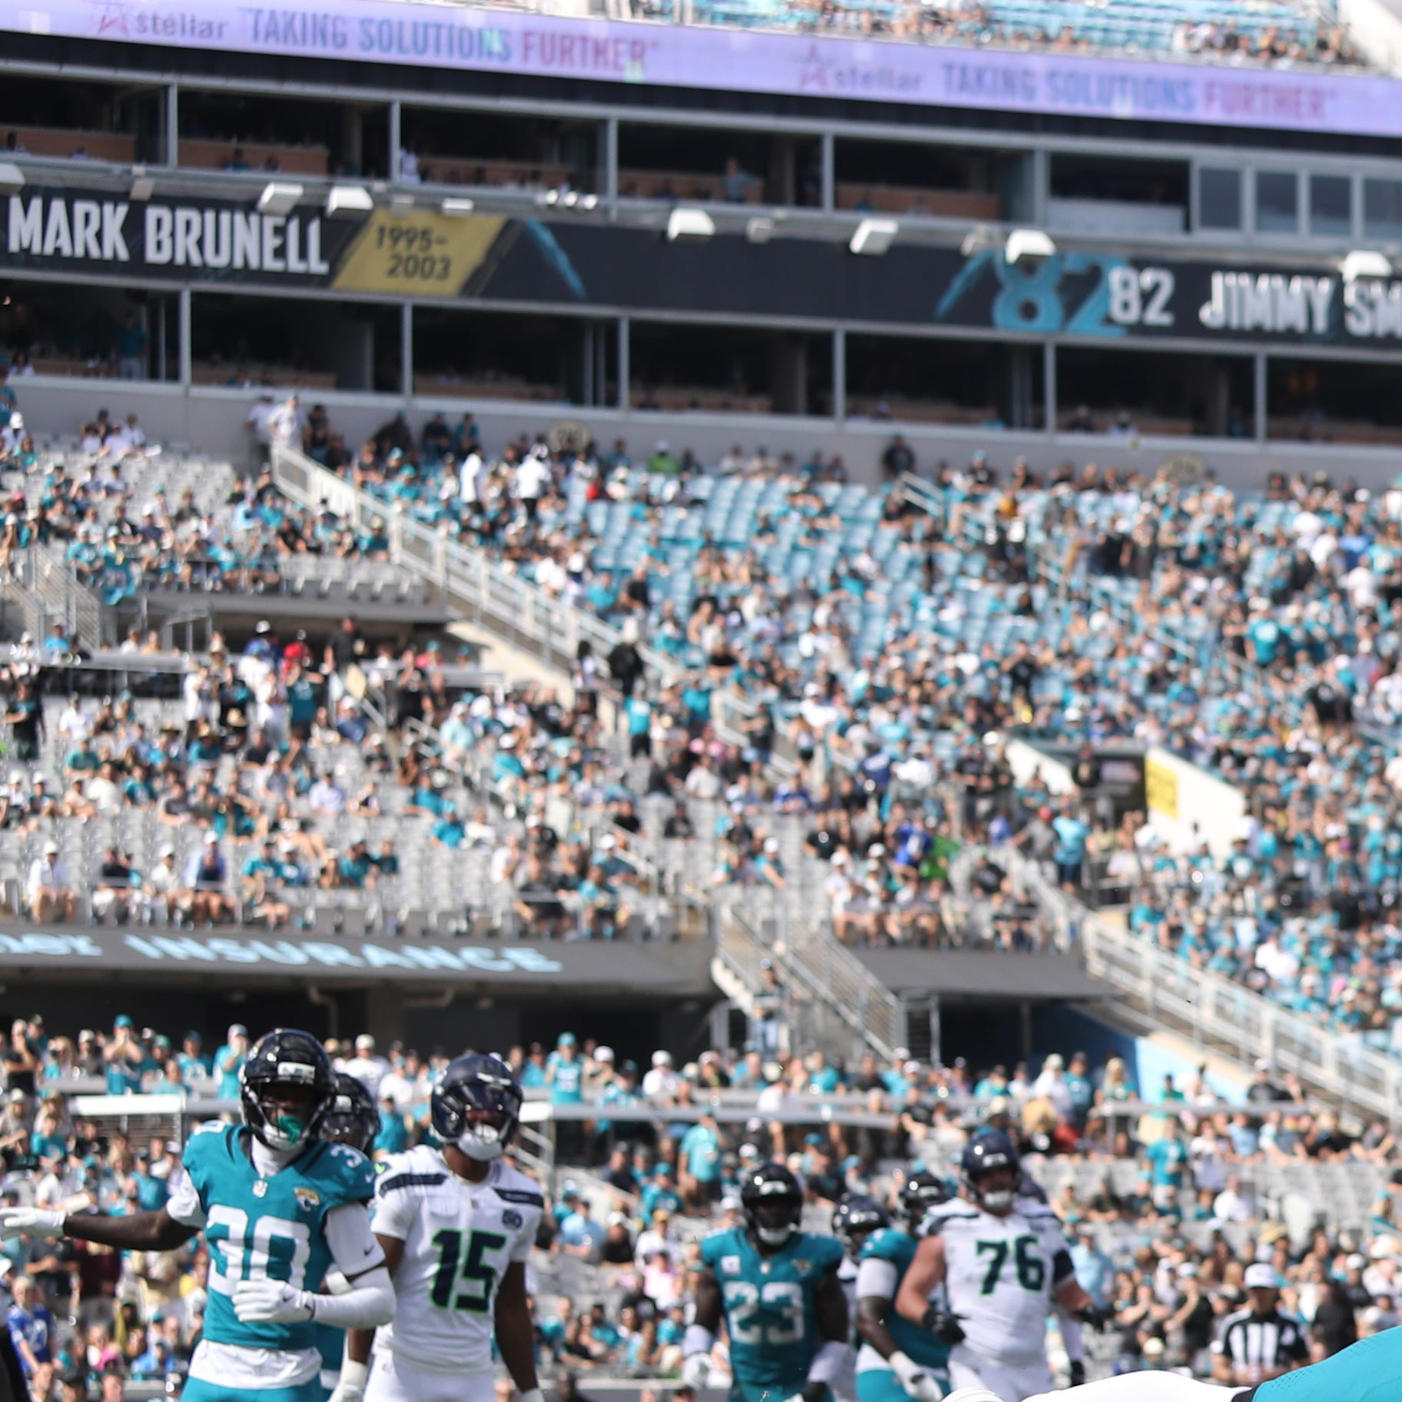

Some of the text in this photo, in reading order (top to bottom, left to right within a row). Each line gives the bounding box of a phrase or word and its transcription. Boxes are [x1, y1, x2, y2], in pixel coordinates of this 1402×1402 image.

[134, 9, 646, 73] stellar TAKING SOLUTIONS FURTHER
[944, 62, 1035, 102] TAKING
[1046, 68, 1193, 112] SOLUTIONS
[1205, 79, 1327, 120] FURTHER
[8, 195, 330, 275] MARK BRUNELL
[387, 252, 451, 281] 2003
[1108, 265, 1175, 326] 82
[1199, 271, 1335, 335] JIMMY
[122, 932, 563, 973] INSURANCE
[205, 1203, 311, 1297] 30
[431, 1228, 508, 1313] 15
[976, 1235, 1046, 1296] 76
[721, 1281, 804, 1345] 23
